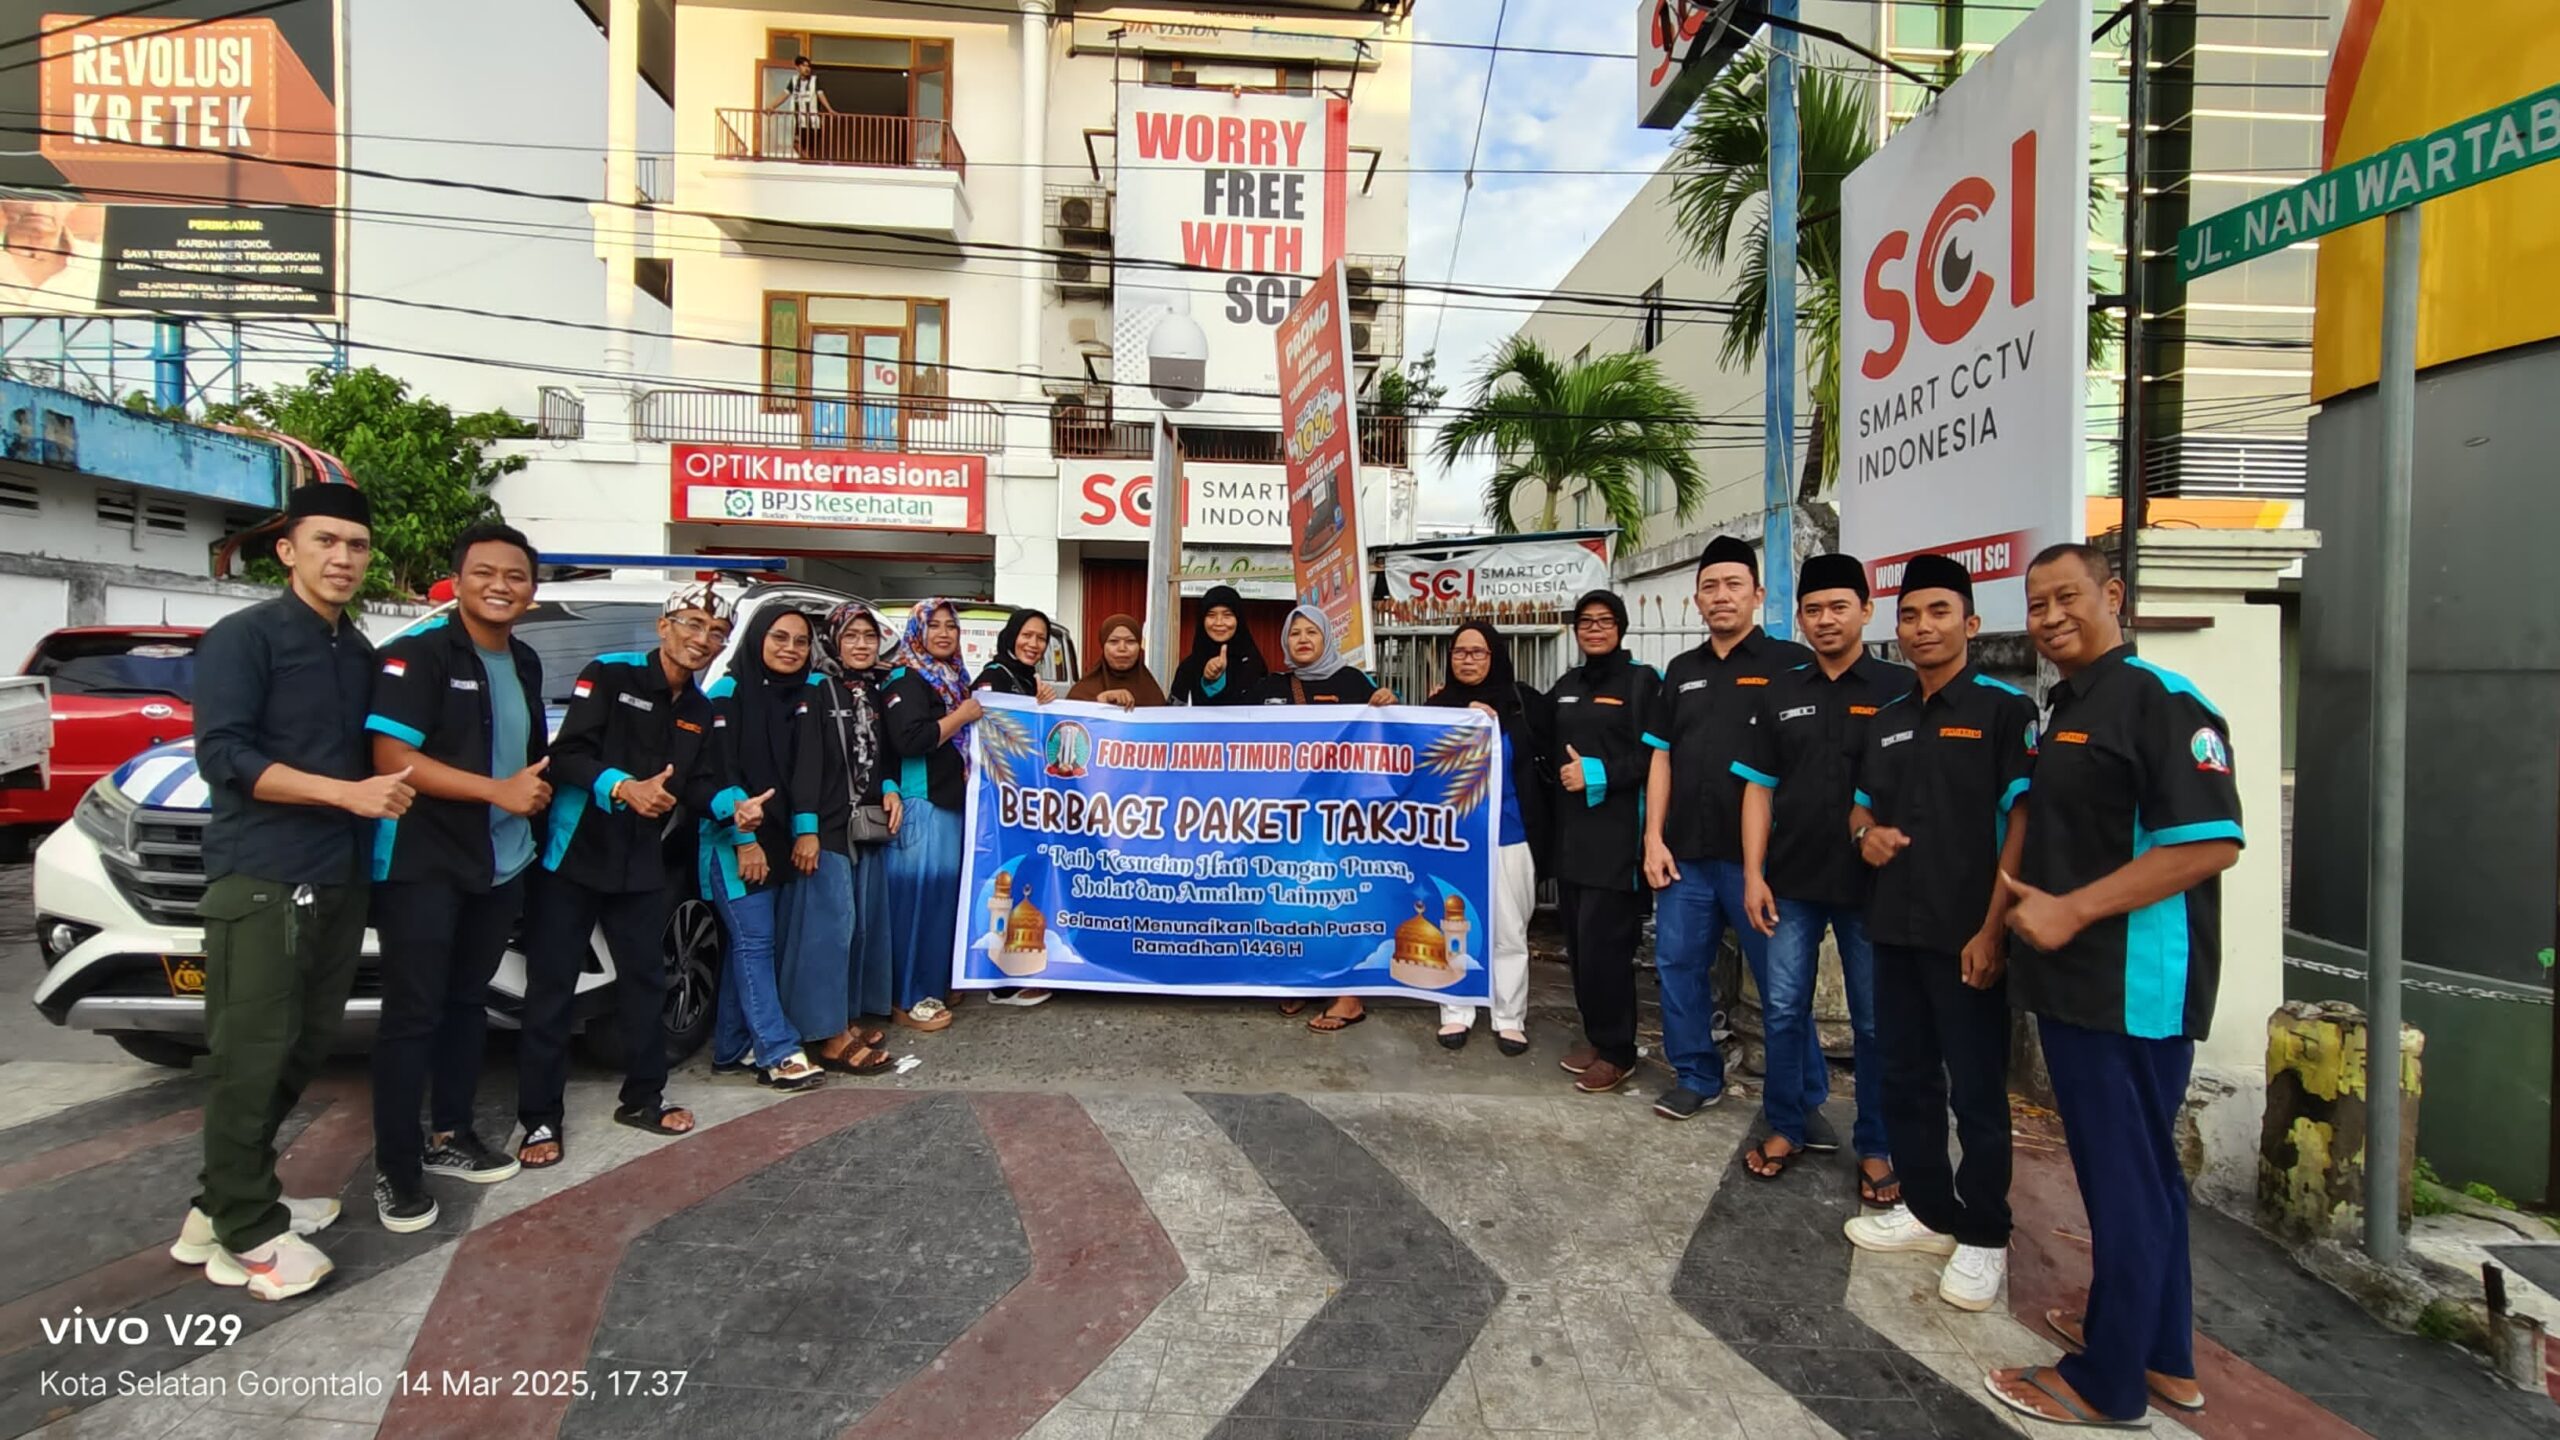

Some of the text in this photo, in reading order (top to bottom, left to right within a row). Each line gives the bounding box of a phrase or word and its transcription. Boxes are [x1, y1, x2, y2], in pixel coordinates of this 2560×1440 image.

[72, 34, 252, 87] REVOLUSI
[72, 93, 252, 147] KRETEK
[1136, 112, 1306, 166] WORRY
[1204, 169, 1305, 220] FREE
[2185, 98, 2560, 271] JL. NANI WARTAB
[122, 249, 320, 261] SAYA TERKENA KANKER TENGGOROKAN
[177, 239, 217, 248] KARENA
[1181, 221, 1303, 273] WITH
[1861, 129, 2037, 379] SCI
[211, 264, 257, 273] MEROKOK
[1285, 300, 1329, 368] PROMO
[1859, 330, 2035, 439] SMART CCTV
[1295, 402, 1332, 462] 10%
[1858, 407, 1998, 484] INDONESIA
[686, 453, 969, 488] OPTIK Internasional
[761, 490, 933, 516] BPJS Kesehatan
[1202, 481, 1288, 501] SMART
[1202, 507, 1291, 527] INDON
[1480, 561, 1585, 580] SMART CCTV
[1875, 562, 1908, 590] WOR
[1985, 542, 2010, 571] SCI
[1409, 569, 1475, 600] SCI
[1480, 580, 1568, 596] INDONESIA
[1097, 740, 1414, 776] FORUM JAWA TIMUR GORONTALO
[1000, 782, 1469, 852] BERBAGI PAKET TAKJIL
[1096, 850, 1193, 877] Kesucian
[1194, 851, 1248, 879] Hati
[1253, 856, 1336, 883] Dengan
[1340, 856, 1414, 884] Puasa,
[1072, 875, 1134, 899] Sholat
[1136, 879, 1174, 903] dan
[1176, 881, 1265, 904] Amalan
[1057, 911, 1386, 937] Selamat Menunaikan Ibadah Puasa
[1133, 938, 1303, 957] Ramadhan 1446 H
